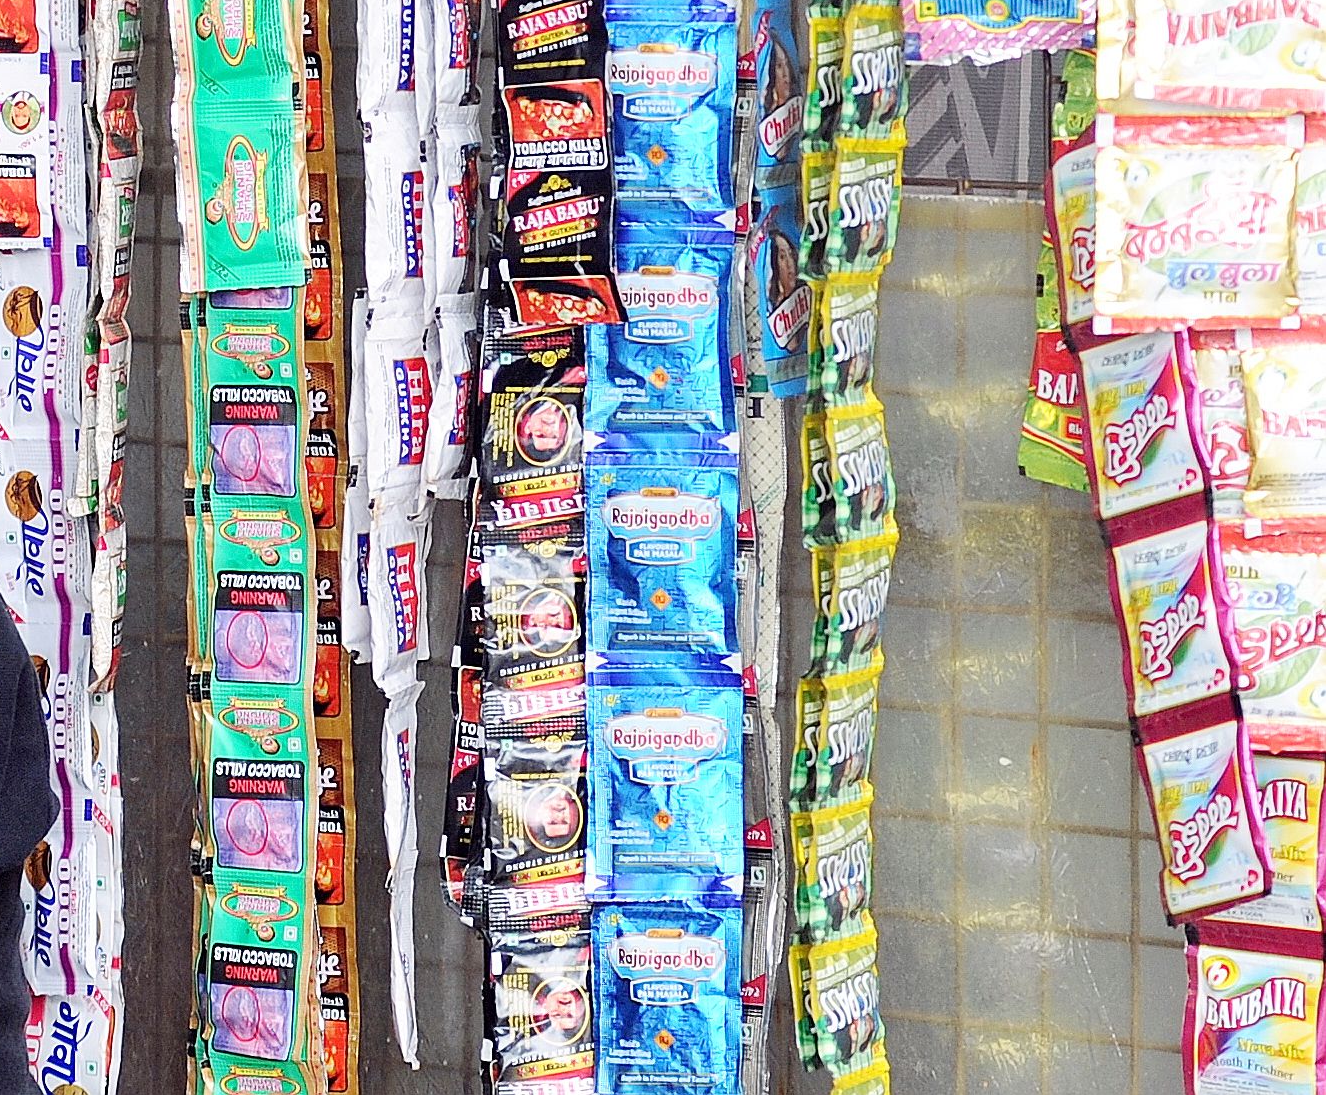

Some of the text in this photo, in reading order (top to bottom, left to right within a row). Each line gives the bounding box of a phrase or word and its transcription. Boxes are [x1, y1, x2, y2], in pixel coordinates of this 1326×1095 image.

[507, 2, 589, 39] RAJA BABU
[610, 61, 709, 87] Rajnigandha
[514, 138, 601, 156] TOBACCO KILLS
[243, 160, 254, 224] STRONG
[401, 178, 416, 273] GUTKHA
[513, 197, 600, 232] RAJA BABU
[621, 285, 709, 310] ajnigandha
[42, 304, 62, 395] 1000
[211, 387, 292, 405] TOBACCO KILLS
[224, 405, 279, 421] WARNING
[394, 366, 410, 459] GUTKHA
[406, 368, 425, 457] Hira
[611, 507, 711, 530] Rajnigandha
[49, 488, 66, 579] 1000
[220, 572, 301, 590] TOBACCO KILLS
[229, 590, 287, 606] WARNING
[394, 551, 416, 642] Hira
[53, 672, 69, 763] 1000
[612, 728, 716, 751] Rajnigandha
[215, 760, 301, 779] TOBACCO KILLS
[229, 778, 286, 794] WARNING
[57, 858, 71, 948] 1000
[214, 945, 294, 968] TOBACCO KILLS
[617, 947, 715, 970] Rajnigandha
[224, 965, 279, 984] WARNING
[1205, 978, 1307, 1029] BAMBAIYA
[1278, 1043, 1306, 1061] Mix
[1247, 1059, 1295, 1082] Freshner
